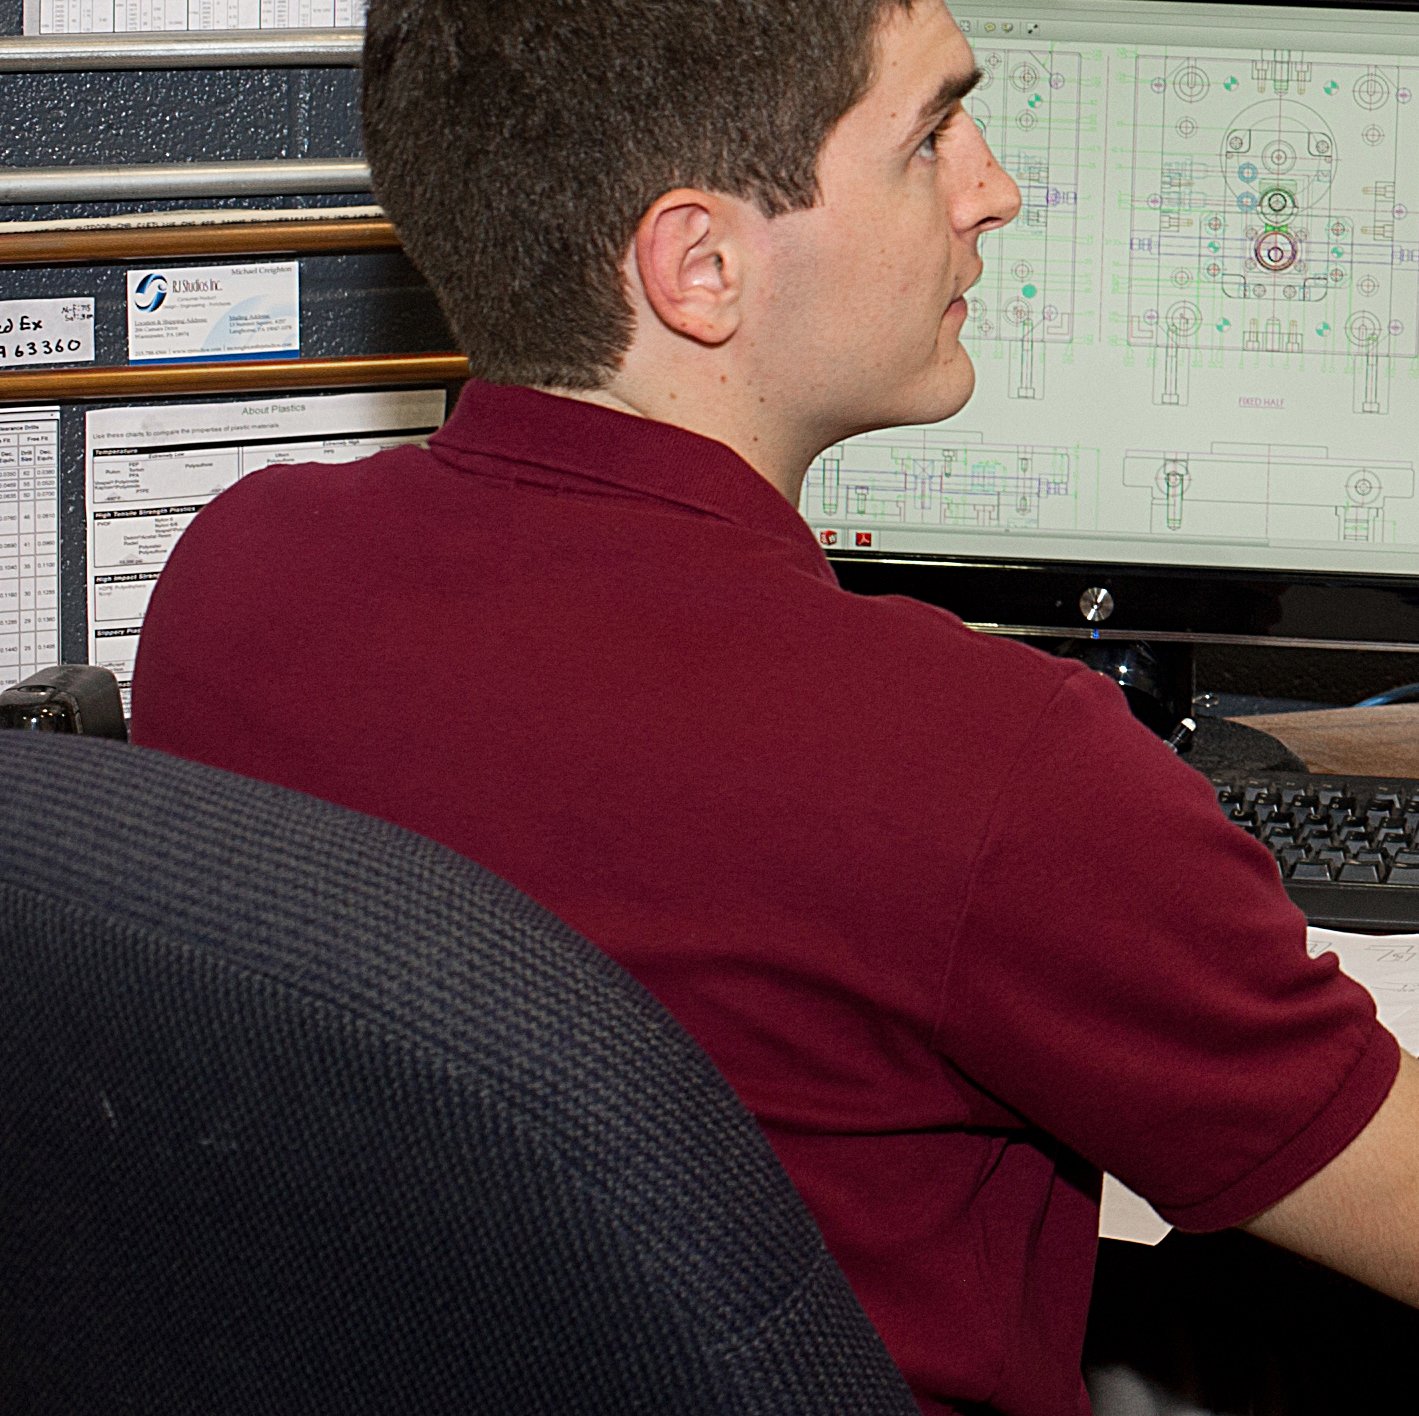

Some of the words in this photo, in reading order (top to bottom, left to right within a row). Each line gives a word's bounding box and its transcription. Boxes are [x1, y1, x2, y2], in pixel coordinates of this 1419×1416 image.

[231, 267, 257, 275] Michael
[259, 266, 292, 275] Creighton
[172, 280, 181, 293] RJ
[182, 279, 209, 292] Studios
[210, 278, 223, 291] Inc.
[20, 316, 42, 331] Ex
[1238, 396, 1262, 407] FIXED
[1263, 397, 1285, 408] HALF
[241, 406, 269, 415] About
[271, 404, 306, 413] Plastics
[153, 429, 179, 437] compare
[192, 427, 222, 435] properties
